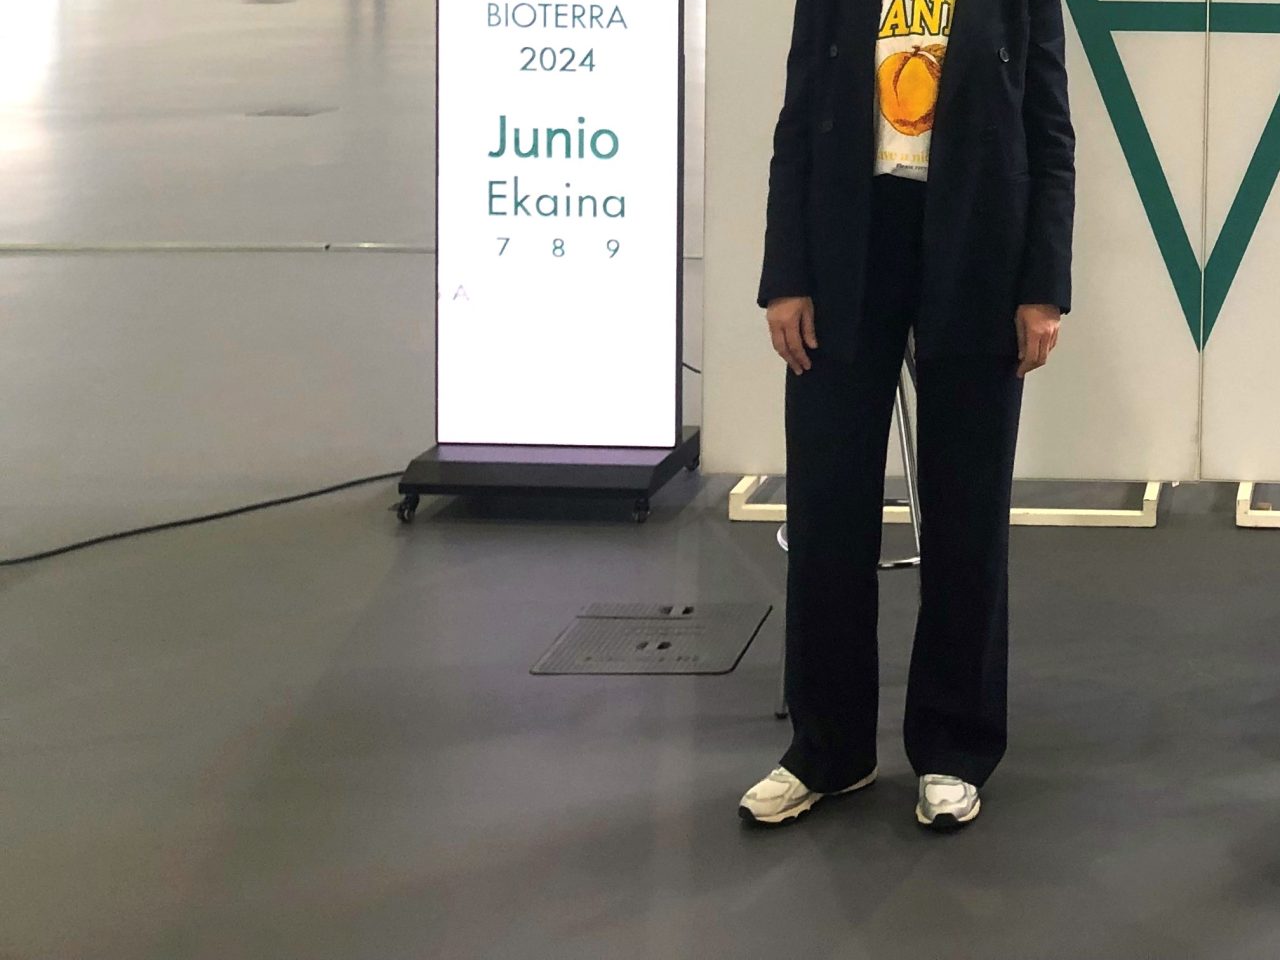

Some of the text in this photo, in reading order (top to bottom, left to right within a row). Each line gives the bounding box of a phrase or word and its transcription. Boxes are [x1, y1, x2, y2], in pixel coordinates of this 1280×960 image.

[487, 2, 628, 30] BIOTERRA
[519, 46, 596, 73] 2024
[487, 114, 620, 160] Junio
[487, 175, 626, 219] Ekaina
[496, 237, 620, 259] 7 8 9
